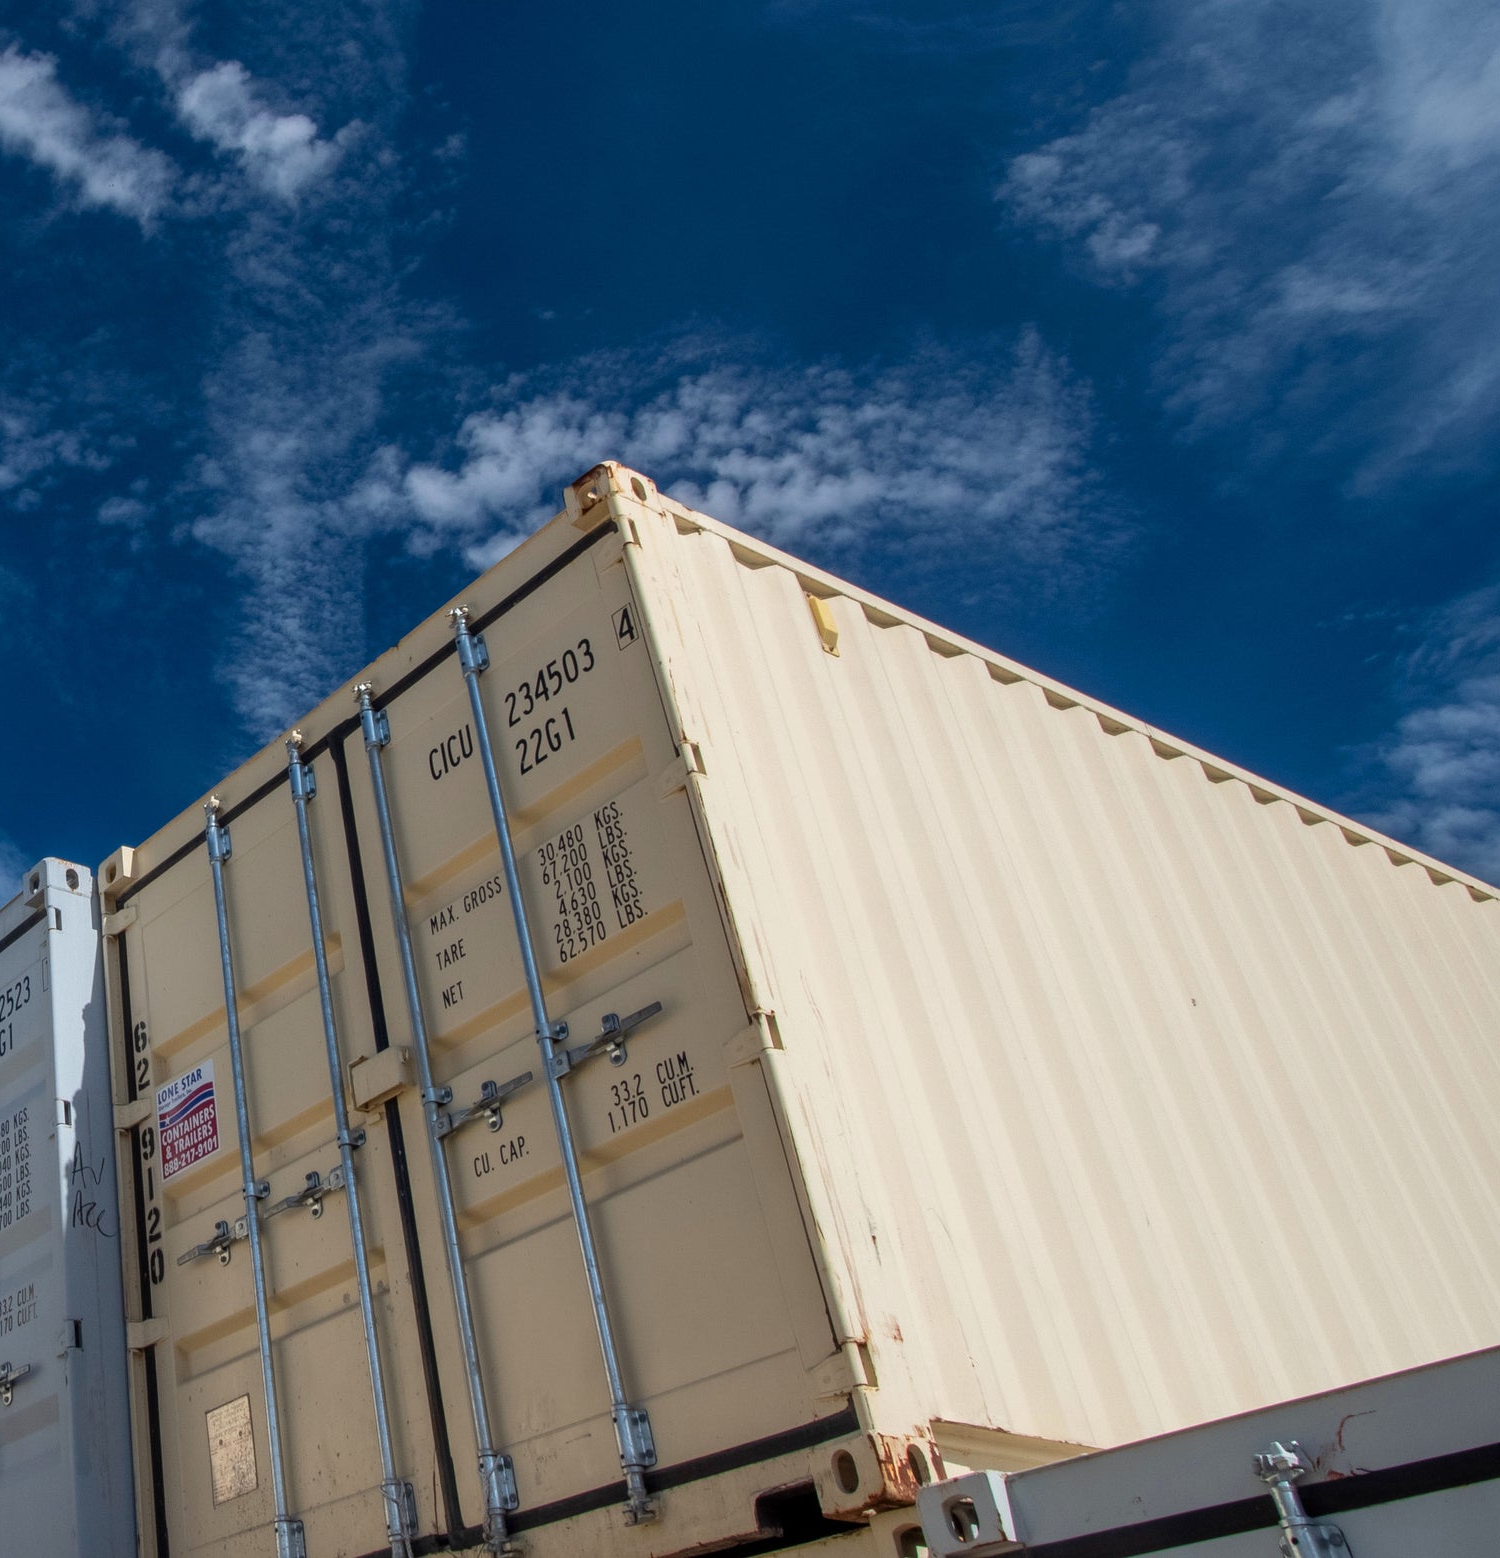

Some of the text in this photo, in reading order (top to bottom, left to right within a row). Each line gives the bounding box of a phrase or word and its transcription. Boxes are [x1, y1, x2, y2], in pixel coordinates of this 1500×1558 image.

[428, 607, 635, 782] CICU 234503 4
[514, 706, 577, 776] 22G1
[593, 801, 623, 831] KGS.
[597, 820, 628, 850] LBS.
[602, 839, 632, 869] KGS.
[606, 858, 637, 889] LBS.
[430, 876, 502, 936] MAX. GROSS
[611, 878, 643, 908] KGS.
[616, 898, 648, 930] LBS.
[435, 938, 467, 971] TARE
[441, 980, 465, 1010] NET
[157, 1067, 203, 1106] LONE STAR
[610, 1073, 645, 1106] 33.2
[161, 1103, 215, 1146] CONTAINERS
[166, 1120, 213, 1160] & TRAILERS
[164, 1134, 218, 1177] 888-217-9101
[473, 1135, 529, 1178] CU. CAP.
